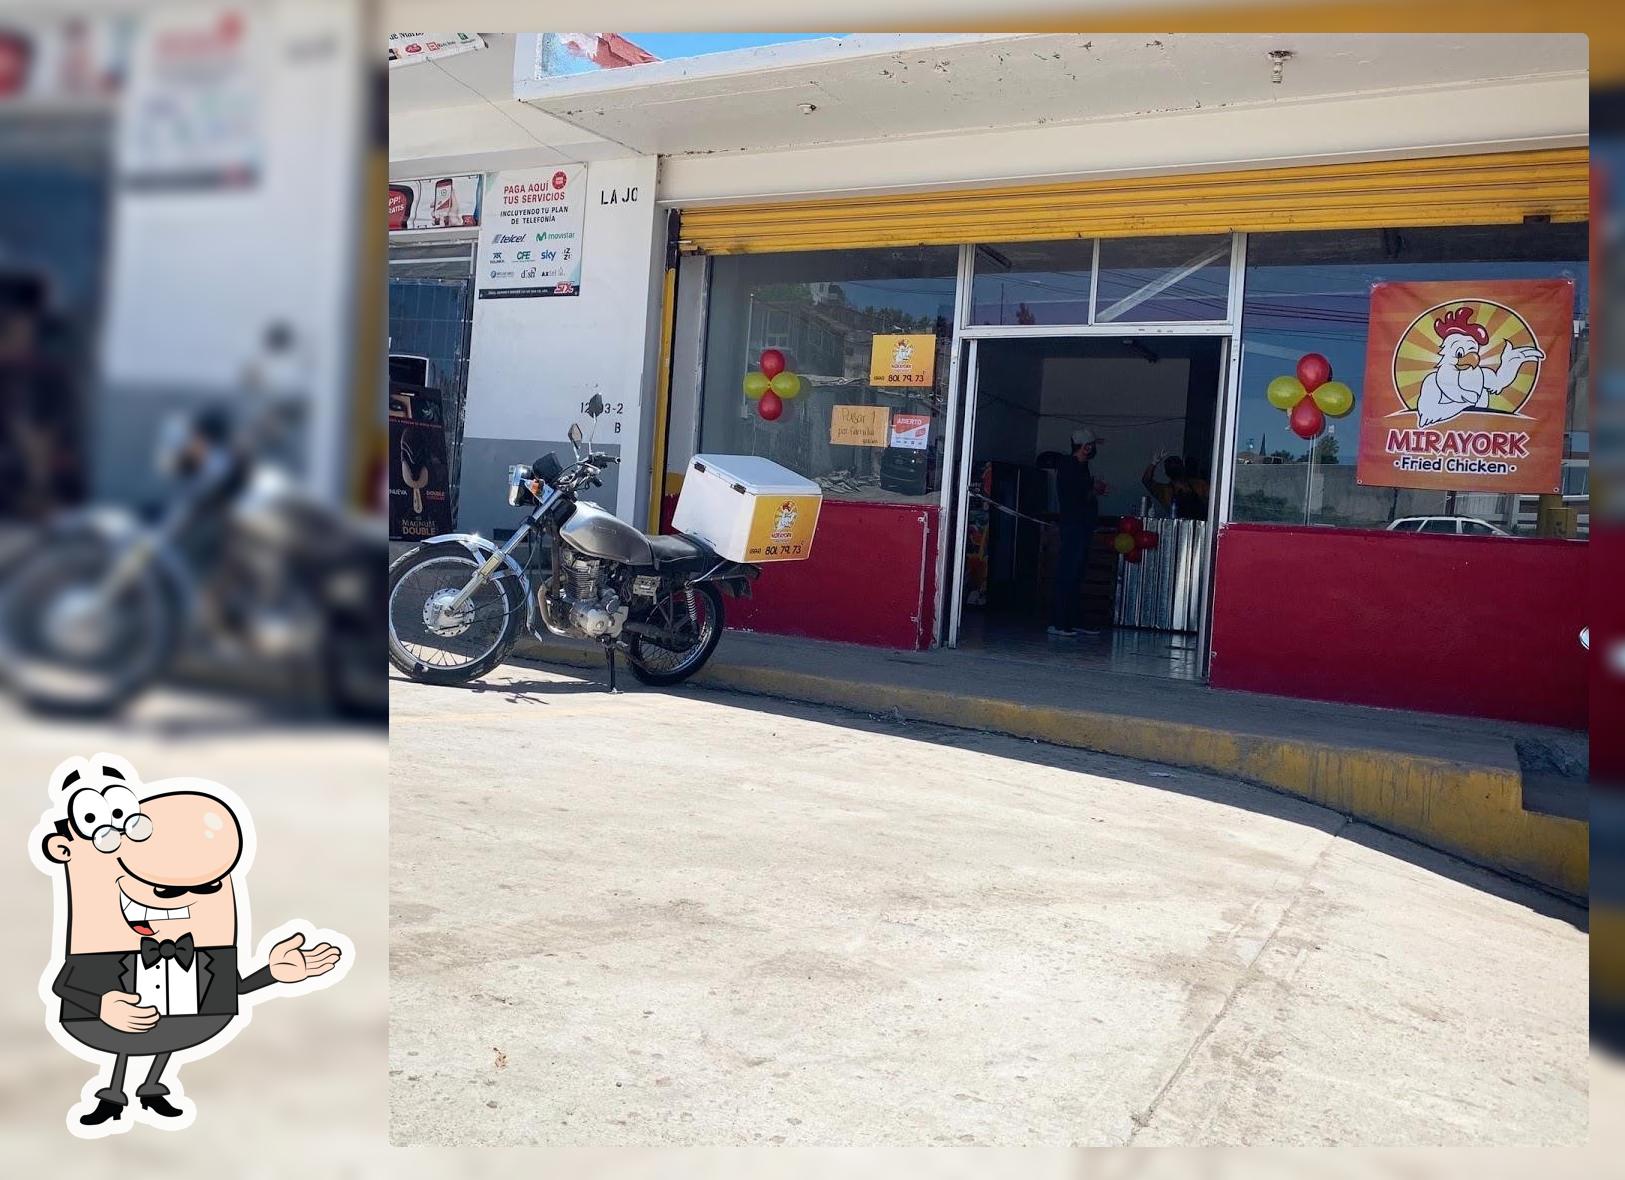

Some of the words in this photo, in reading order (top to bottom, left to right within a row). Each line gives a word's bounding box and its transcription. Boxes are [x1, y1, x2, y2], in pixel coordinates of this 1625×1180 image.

[504, 184, 526, 194] PAGA
[528, 180, 549, 193] AQUÍ
[504, 195, 519, 205] TUS
[521, 191, 565, 204] SERVICIOS
[601, 189, 618, 205] LA
[500, 208, 540, 217] INCLUYENDO
[522, 215, 556, 224] TELEFONÍA
[548, 232, 575, 240] movistar
[516, 250, 532, 260] CFE
[541, 249, 557, 261] sky
[614, 421, 621, 434] B
[1388, 429, 1530, 457] MIRAYORK
[1400, 456, 1442, 473] Fried
[1446, 458, 1508, 474] Chicken
[402, 527, 437, 536] DOUBLE
